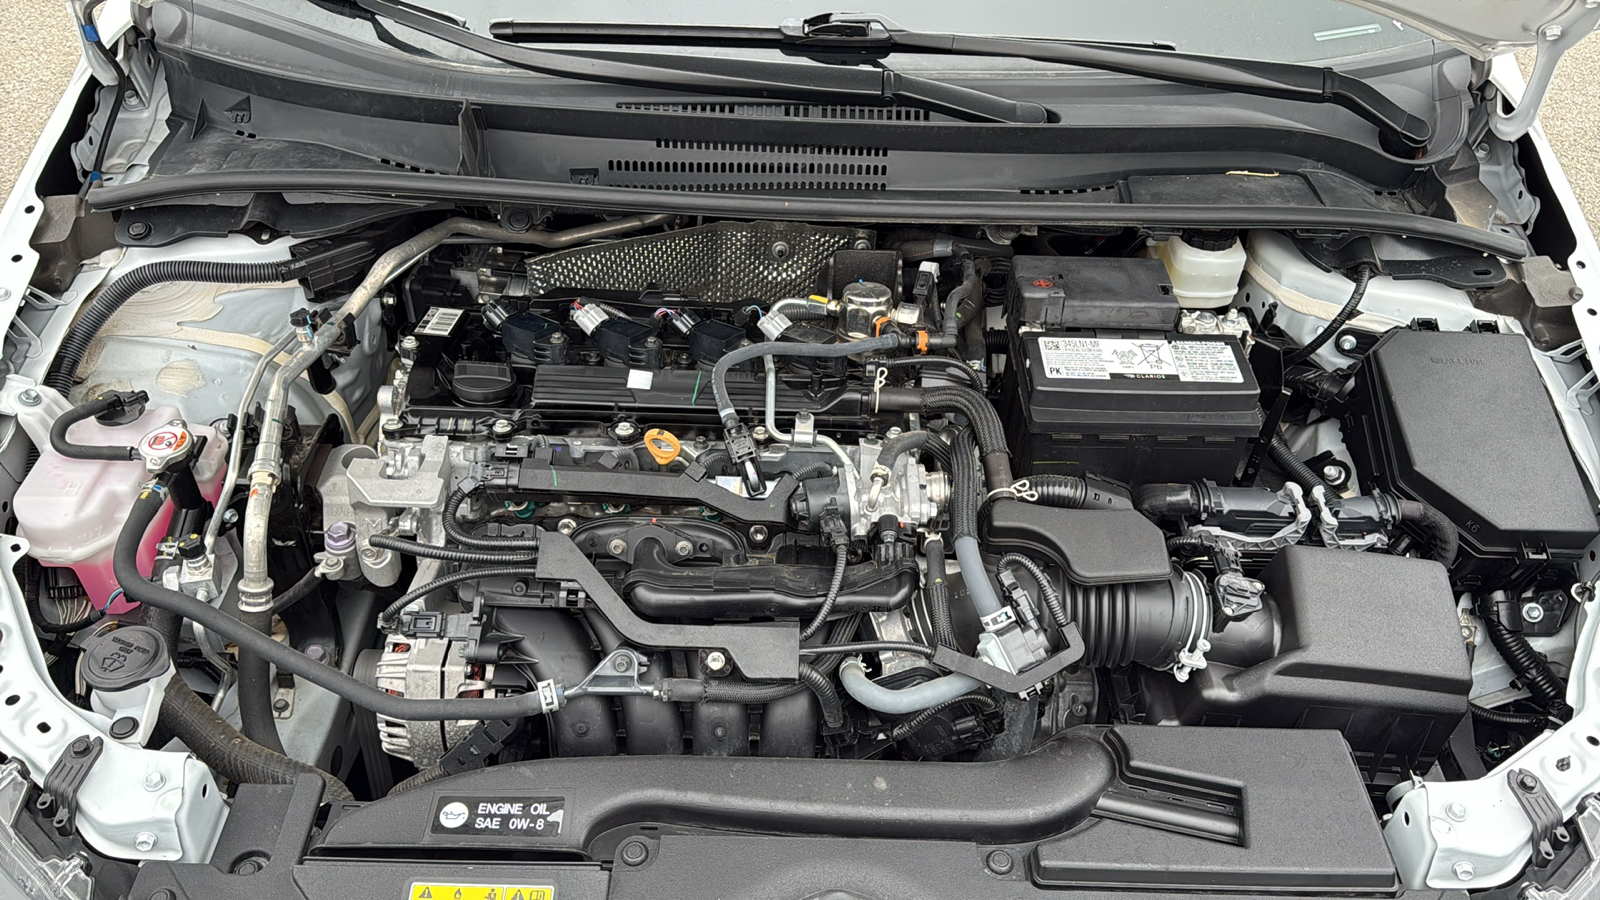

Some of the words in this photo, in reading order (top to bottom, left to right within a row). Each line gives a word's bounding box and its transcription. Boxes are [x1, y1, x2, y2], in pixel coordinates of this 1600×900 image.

[1049, 367, 1062, 375] PK
[1465, 519, 1480, 533] K6
[477, 803, 523, 815] ENGINE
[530, 803, 550, 815] OIL
[475, 818, 501, 829] SAE
[509, 818, 544, 830] 0W-8
